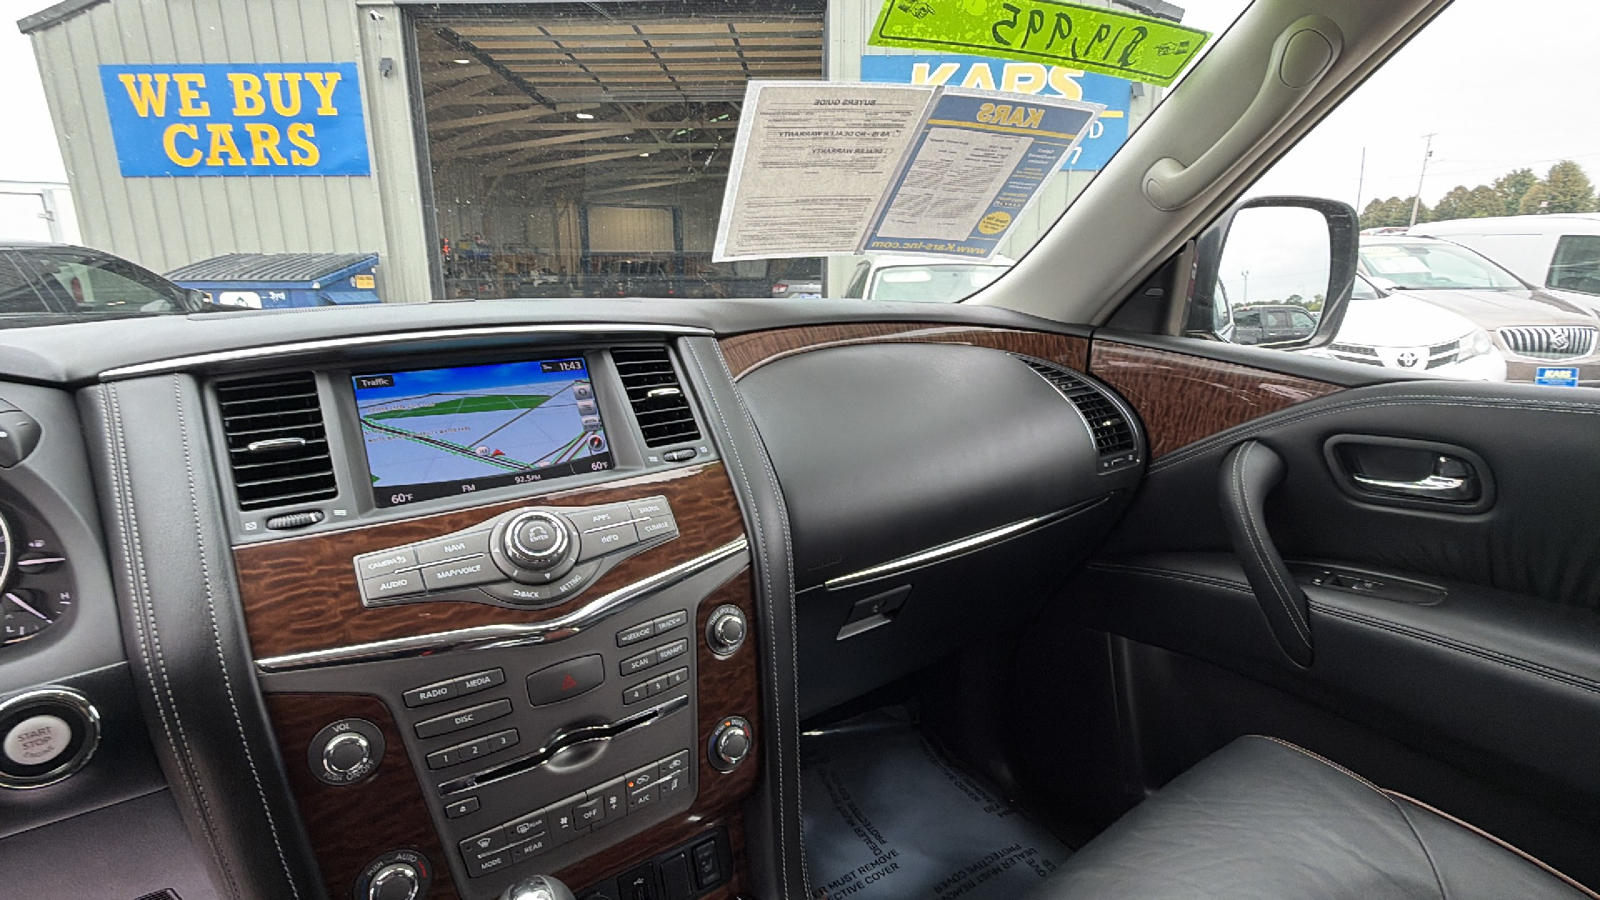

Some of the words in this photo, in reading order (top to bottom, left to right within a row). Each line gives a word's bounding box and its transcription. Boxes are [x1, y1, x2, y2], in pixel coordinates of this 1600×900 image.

[117, 73, 211, 117] WE
[227, 72, 342, 117] BUY
[162, 123, 321, 167] CARS
[558, 361, 582, 371] 11:43
[361, 378, 389, 387] Traffic
[462, 484, 476, 493] FM
[592, 513, 611, 522] APPS
[601, 534, 619, 544] INFO
[444, 542, 466, 553] NAVI
[379, 579, 408, 591] AUDIO
[559, 574, 582, 593] SETTING
[631, 658, 649, 669] SCAN
[465, 676, 491, 688] MEDIA
[675, 674, 681, 682] 6
[655, 682, 661, 690] 5
[419, 687, 448, 700] RADIO
[454, 713, 474, 725] DISC
[332, 723, 350, 733] VOL
[17, 726, 52, 743] START
[21, 736, 52, 751] STOP
[501, 737, 507, 745] 3
[472, 746, 478, 754] 2
[638, 795, 649, 804] A/C
[583, 809, 597, 819] OFF
[524, 842, 543, 854] REAR
[394, 853, 417, 863] AUTO
[481, 857, 502, 870] MODE
[828, 870, 859, 891] MUST
[856, 848, 900, 876] REMOVE
[864, 862, 900, 885] COVER
[932, 868, 968, 894] COVER
